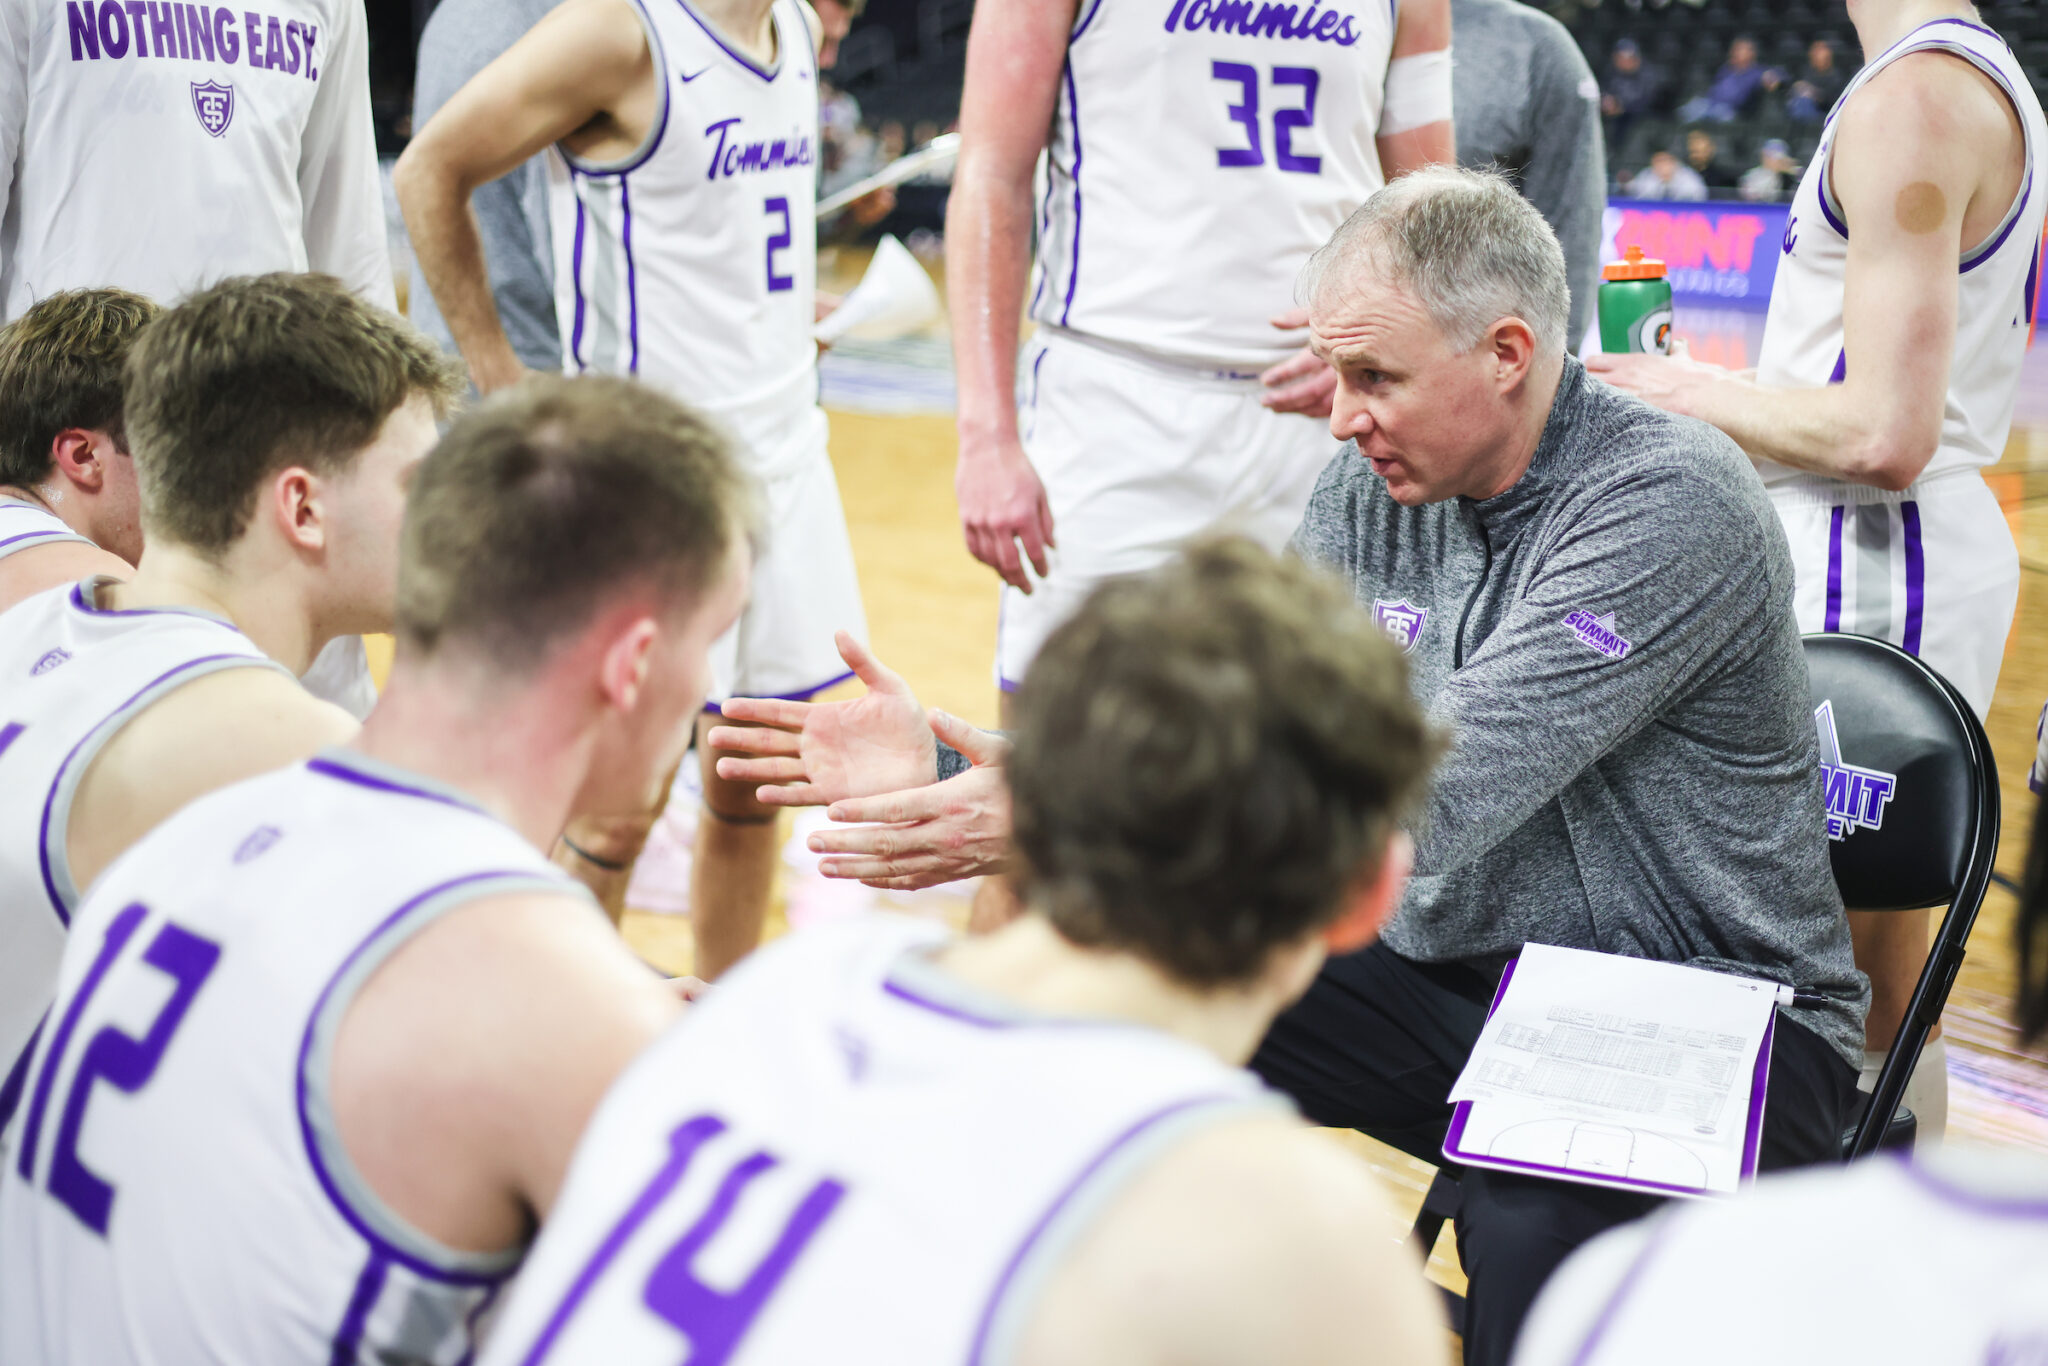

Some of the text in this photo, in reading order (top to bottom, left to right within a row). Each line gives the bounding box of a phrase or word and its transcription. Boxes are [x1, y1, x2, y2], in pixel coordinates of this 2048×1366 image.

[66, 0, 318, 82] NOTHING EASY.
[1211, 60, 1322, 174] 32
[765, 197, 793, 292] 2
[1564, 612, 1629, 655] SUMMIT
[1576, 632, 1611, 655] LEAGUE
[1821, 766, 1890, 822] MIT
[16, 900, 223, 1240] 12
[518, 1113, 850, 1366] 14
